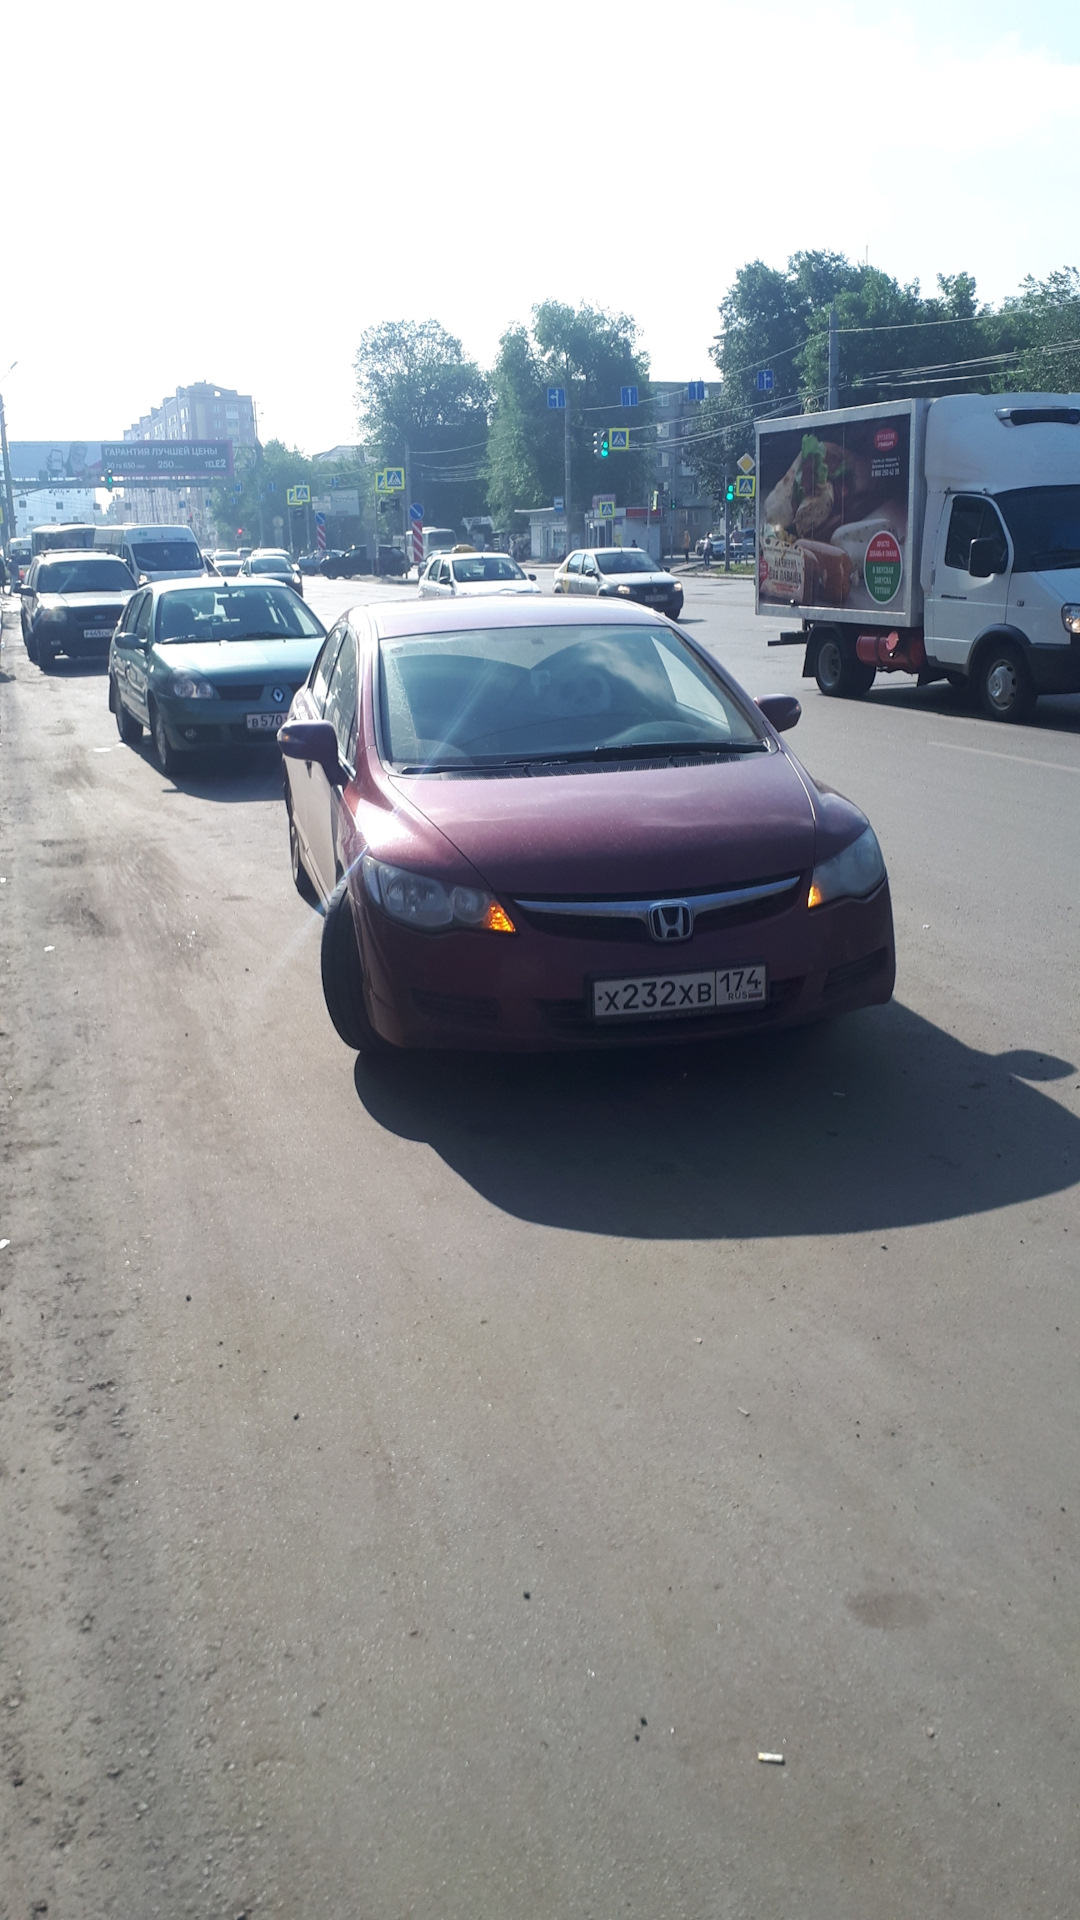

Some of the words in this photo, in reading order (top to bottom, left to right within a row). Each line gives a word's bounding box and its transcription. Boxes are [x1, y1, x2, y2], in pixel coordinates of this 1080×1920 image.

[105, 447, 150, 456] ГАРАНТИЯ
[151, 446, 190, 456] ЛУЧШЕЙ
[192, 447, 218, 457] ЦЕНЫ
[157, 460, 174, 469] 250
[205, 458, 227, 468] TELE2
[876, 565, 894, 575] ВКУСНАЯ
[604, 980, 712, 1012] Х232ХВ
[719, 969, 760, 993] 174
[727, 991, 748, 1001] RUS
